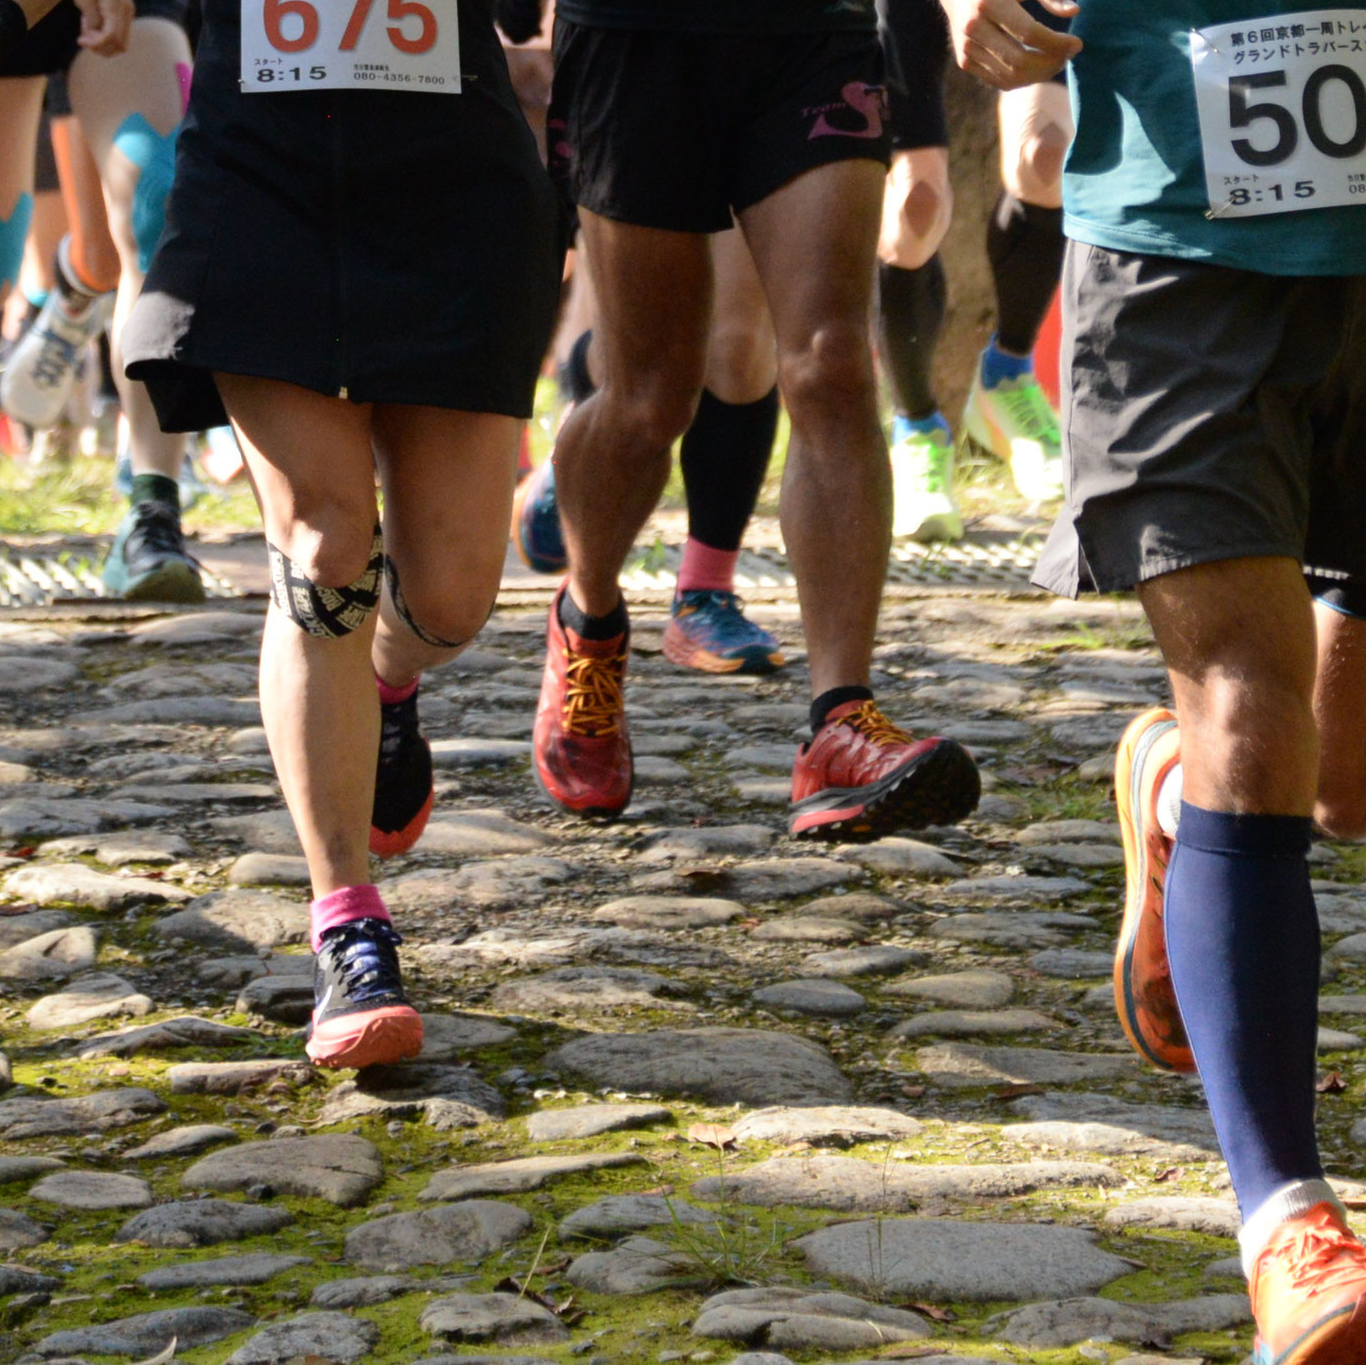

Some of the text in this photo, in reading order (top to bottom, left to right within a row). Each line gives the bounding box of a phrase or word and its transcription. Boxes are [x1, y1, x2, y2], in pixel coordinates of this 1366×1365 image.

[254, 58, 284, 66] スタート
[256, 66, 327, 83] 8:15
[353, 72, 445, 85] 080-4356-7800
[1223, 174, 1260, 186] スタート
[1229, 180, 1317, 206] 8:15
